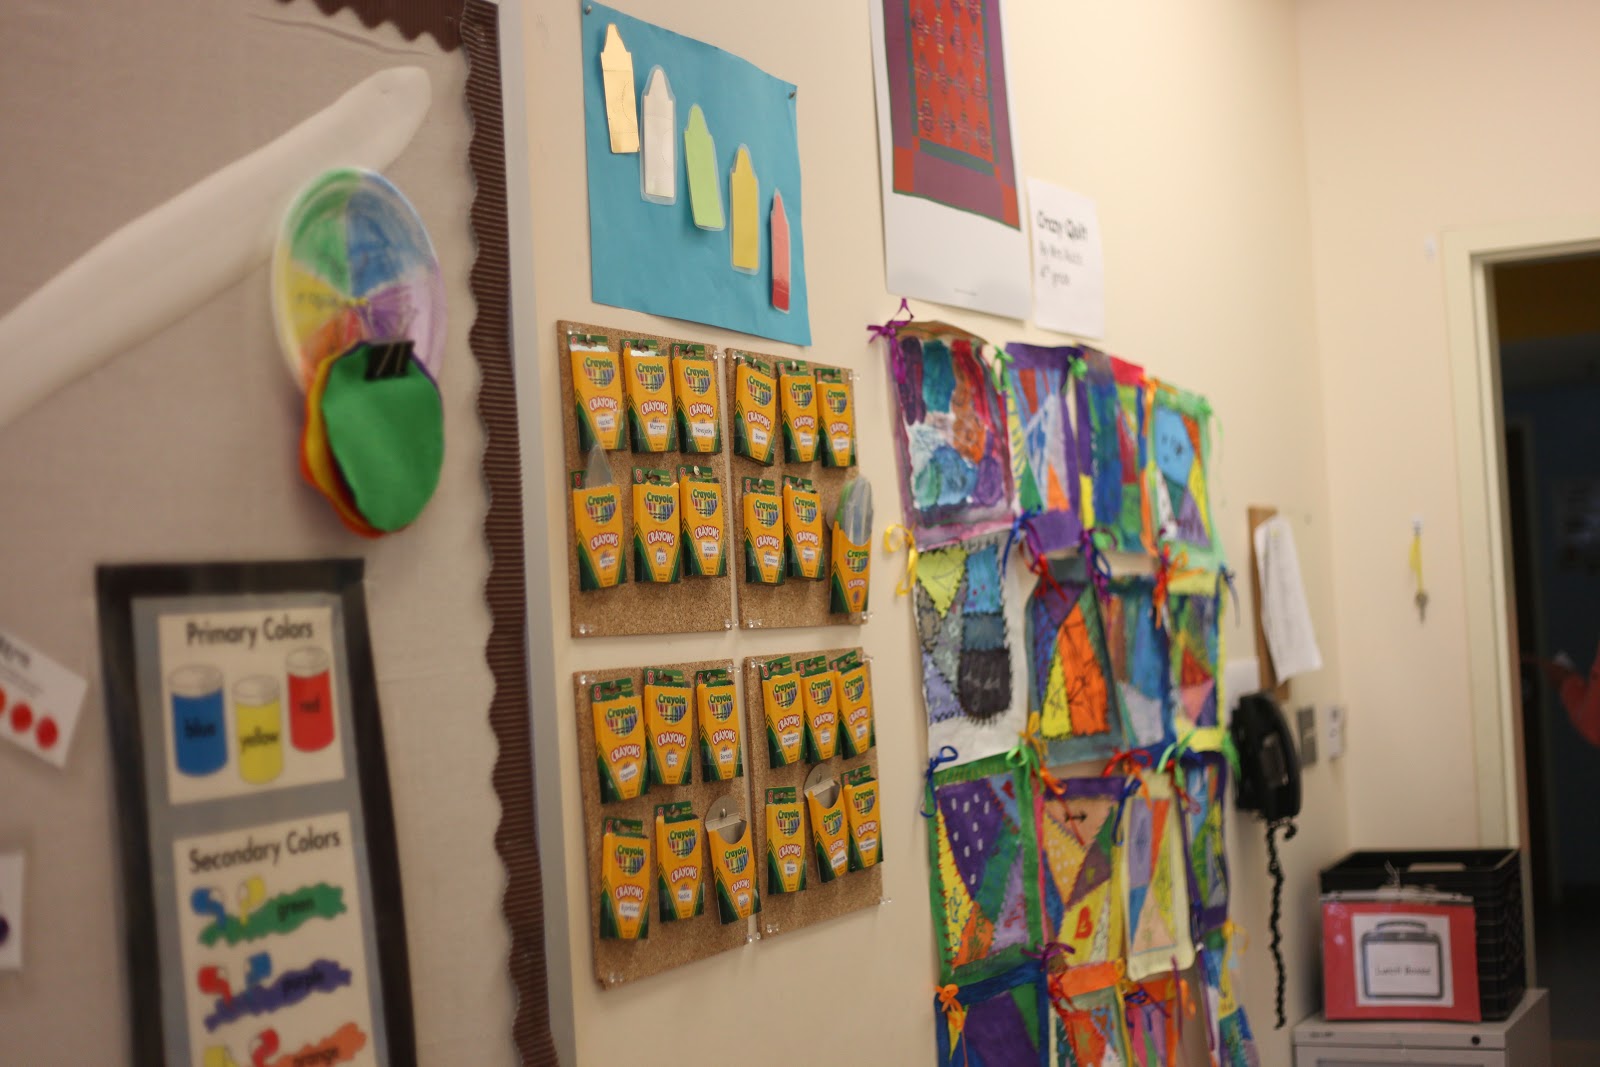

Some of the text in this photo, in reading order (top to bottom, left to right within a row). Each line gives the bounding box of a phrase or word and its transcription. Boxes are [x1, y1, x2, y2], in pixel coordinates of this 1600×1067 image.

[585, 357, 613, 370] Crayola
[637, 362, 664, 375] Crayola
[685, 366, 710, 378] Crayola
[748, 375, 771, 392] Crayola
[791, 382, 812, 393] Crayola
[827, 390, 846, 399] Crayola
[589, 396, 618, 412] CRAYONS
[641, 400, 668, 415] CRAYONS
[689, 402, 714, 418] CRAYONS
[747, 410, 771, 431] CRAYONS
[793, 415, 815, 430] CRAYONS
[587, 493, 615, 506] Crayola
[646, 492, 674, 505] Crayola
[692, 488, 717, 501] Crayola
[794, 496, 816, 508] Crayola
[755, 499, 778, 511] Crayola
[647, 529, 675, 546] CRAYONS
[695, 524, 720, 541] CRAYONS
[796, 531, 819, 546] CRAYONS
[590, 532, 619, 551] CRAYONS
[756, 534, 780, 550] CRAYONS
[187, 614, 313, 650] Primary Colors
[774, 680, 796, 693] Crayola
[811, 679, 831, 690] Crayola
[844, 675, 863, 689] Crayola
[658, 693, 686, 707] Crayola
[709, 693, 732, 706] Crayola
[607, 705, 636, 719] Crayola
[848, 706, 868, 725] CRAYONS
[777, 714, 801, 732] CRAYONS
[813, 711, 835, 729] CRAYONS
[657, 731, 687, 748] CRAYONS
[712, 728, 737, 745] CRAYONS
[610, 743, 641, 763] CRAYONS
[854, 788, 874, 800] Crayola
[778, 809, 800, 821] Crayola
[823, 809, 841, 824] Crayola
[669, 828, 695, 841] Crayola
[857, 820, 877, 838] CRAYONS
[189, 825, 341, 873] Secondary Colors
[617, 844, 644, 857] Crayola
[724, 846, 747, 860] Crayola
[778, 843, 801, 860] CRAYONS
[671, 866, 698, 882] CRAYONS
[615, 884, 644, 901] CRAYONS
[731, 878, 750, 894] CRAYONS
